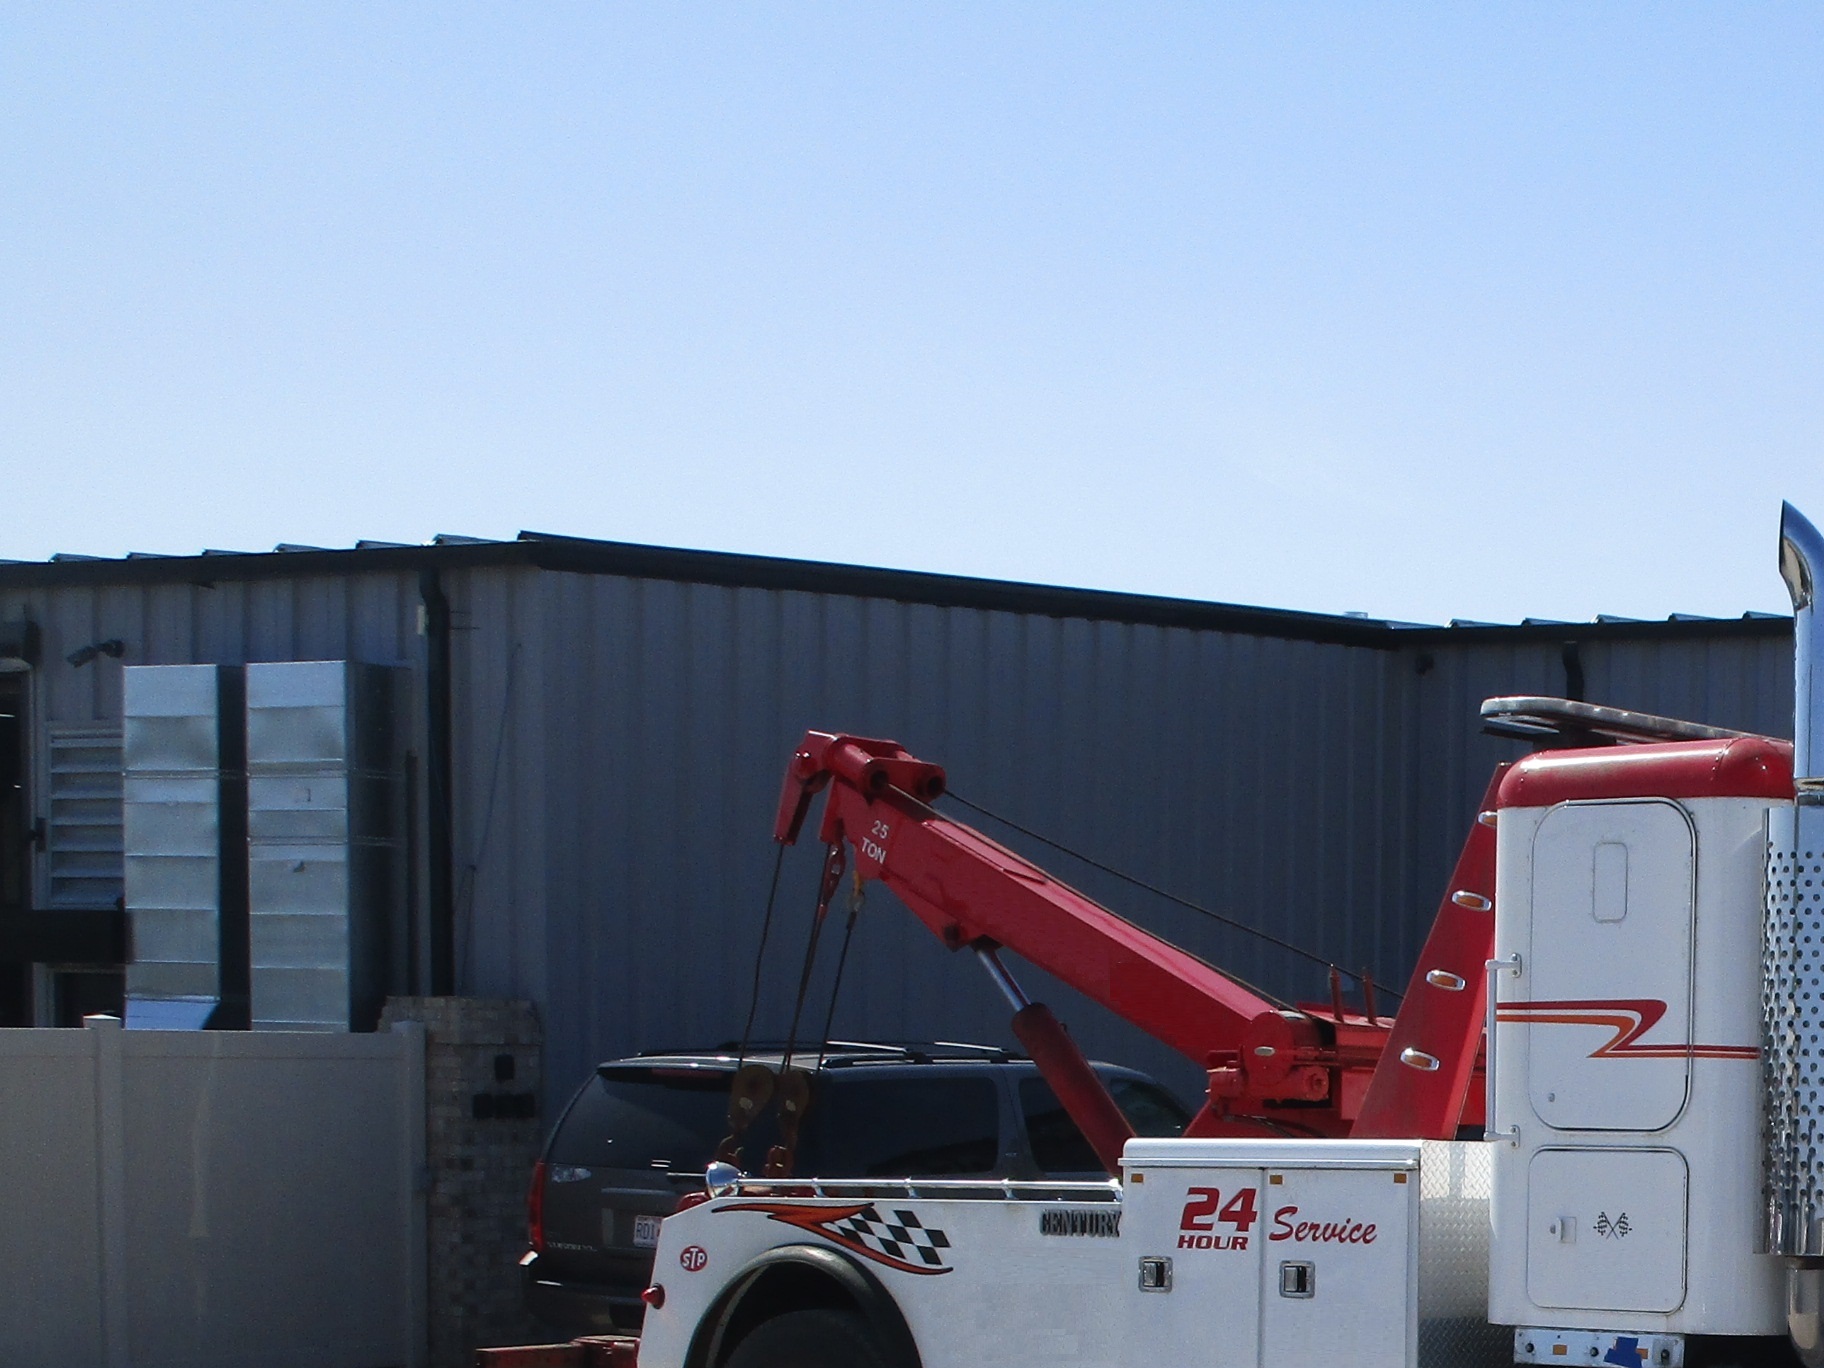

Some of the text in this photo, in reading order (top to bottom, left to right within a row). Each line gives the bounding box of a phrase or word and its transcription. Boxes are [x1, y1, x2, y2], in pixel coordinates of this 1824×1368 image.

[871, 820, 889, 839] 25
[861, 836, 887, 865] TON
[1040, 1208, 1122, 1238] CENTURY
[1180, 1186, 1258, 1232] 24
[1268, 1205, 1378, 1244] Service
[1177, 1234, 1249, 1251] HOUR
[682, 1247, 706, 1269] STP
